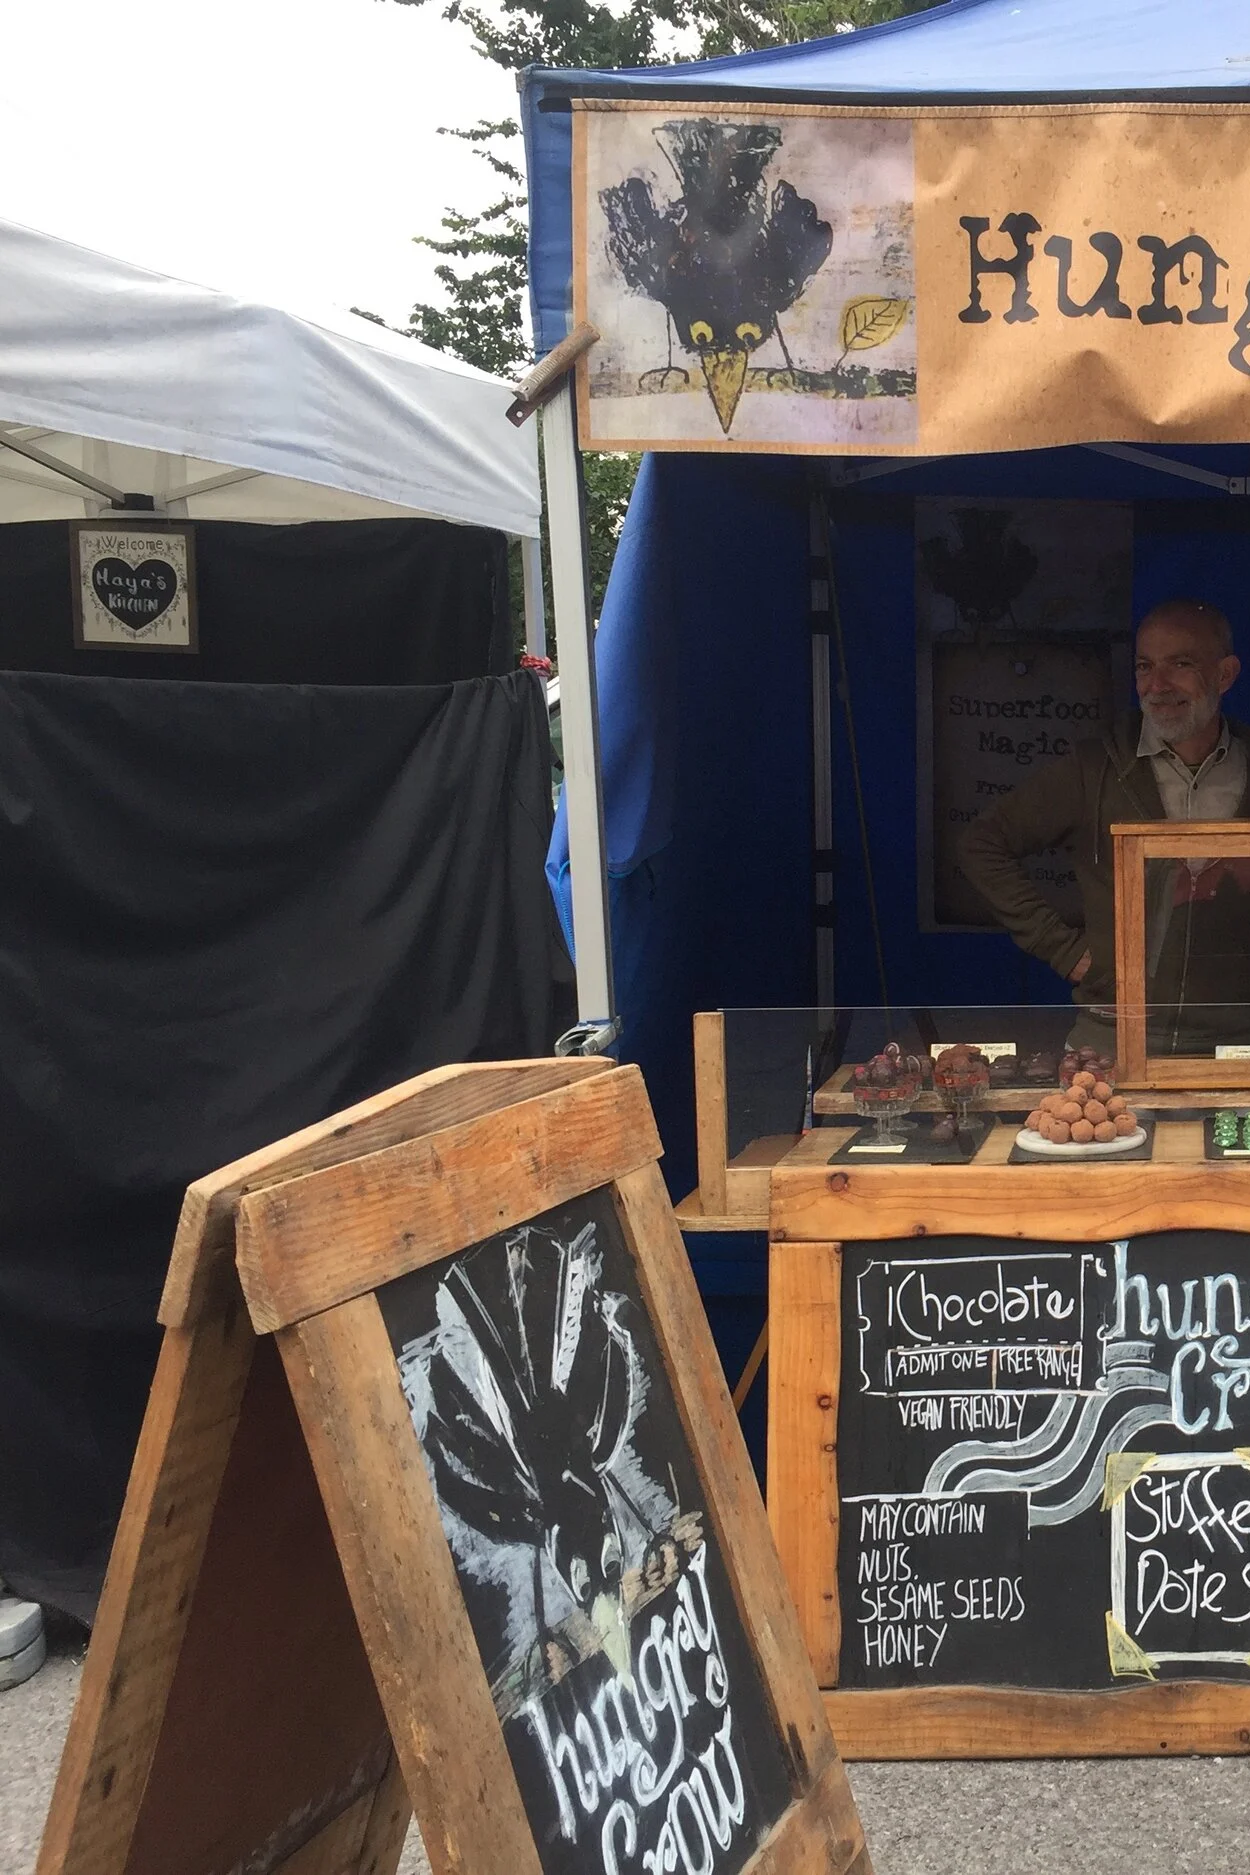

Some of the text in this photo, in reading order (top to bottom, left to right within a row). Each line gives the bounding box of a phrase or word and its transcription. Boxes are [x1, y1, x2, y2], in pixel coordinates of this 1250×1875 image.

[101, 535, 163, 551] Welcome
[949, 695, 1101, 721] Superfood
[978, 731, 1071, 766] Magic
[897, 1263, 1075, 1341] Chocolate
[896, 1348, 1080, 1386] ADMIT ONE FREE RANGE
[899, 1393, 1027, 1440] VEGAN FRIENDLY
[860, 1501, 986, 1542] MAY CONTAIN
[857, 1576, 1026, 1623] SESAME SEEDS
[864, 1623, 948, 1668] HONEY
[514, 1541, 730, 1843] hungry
